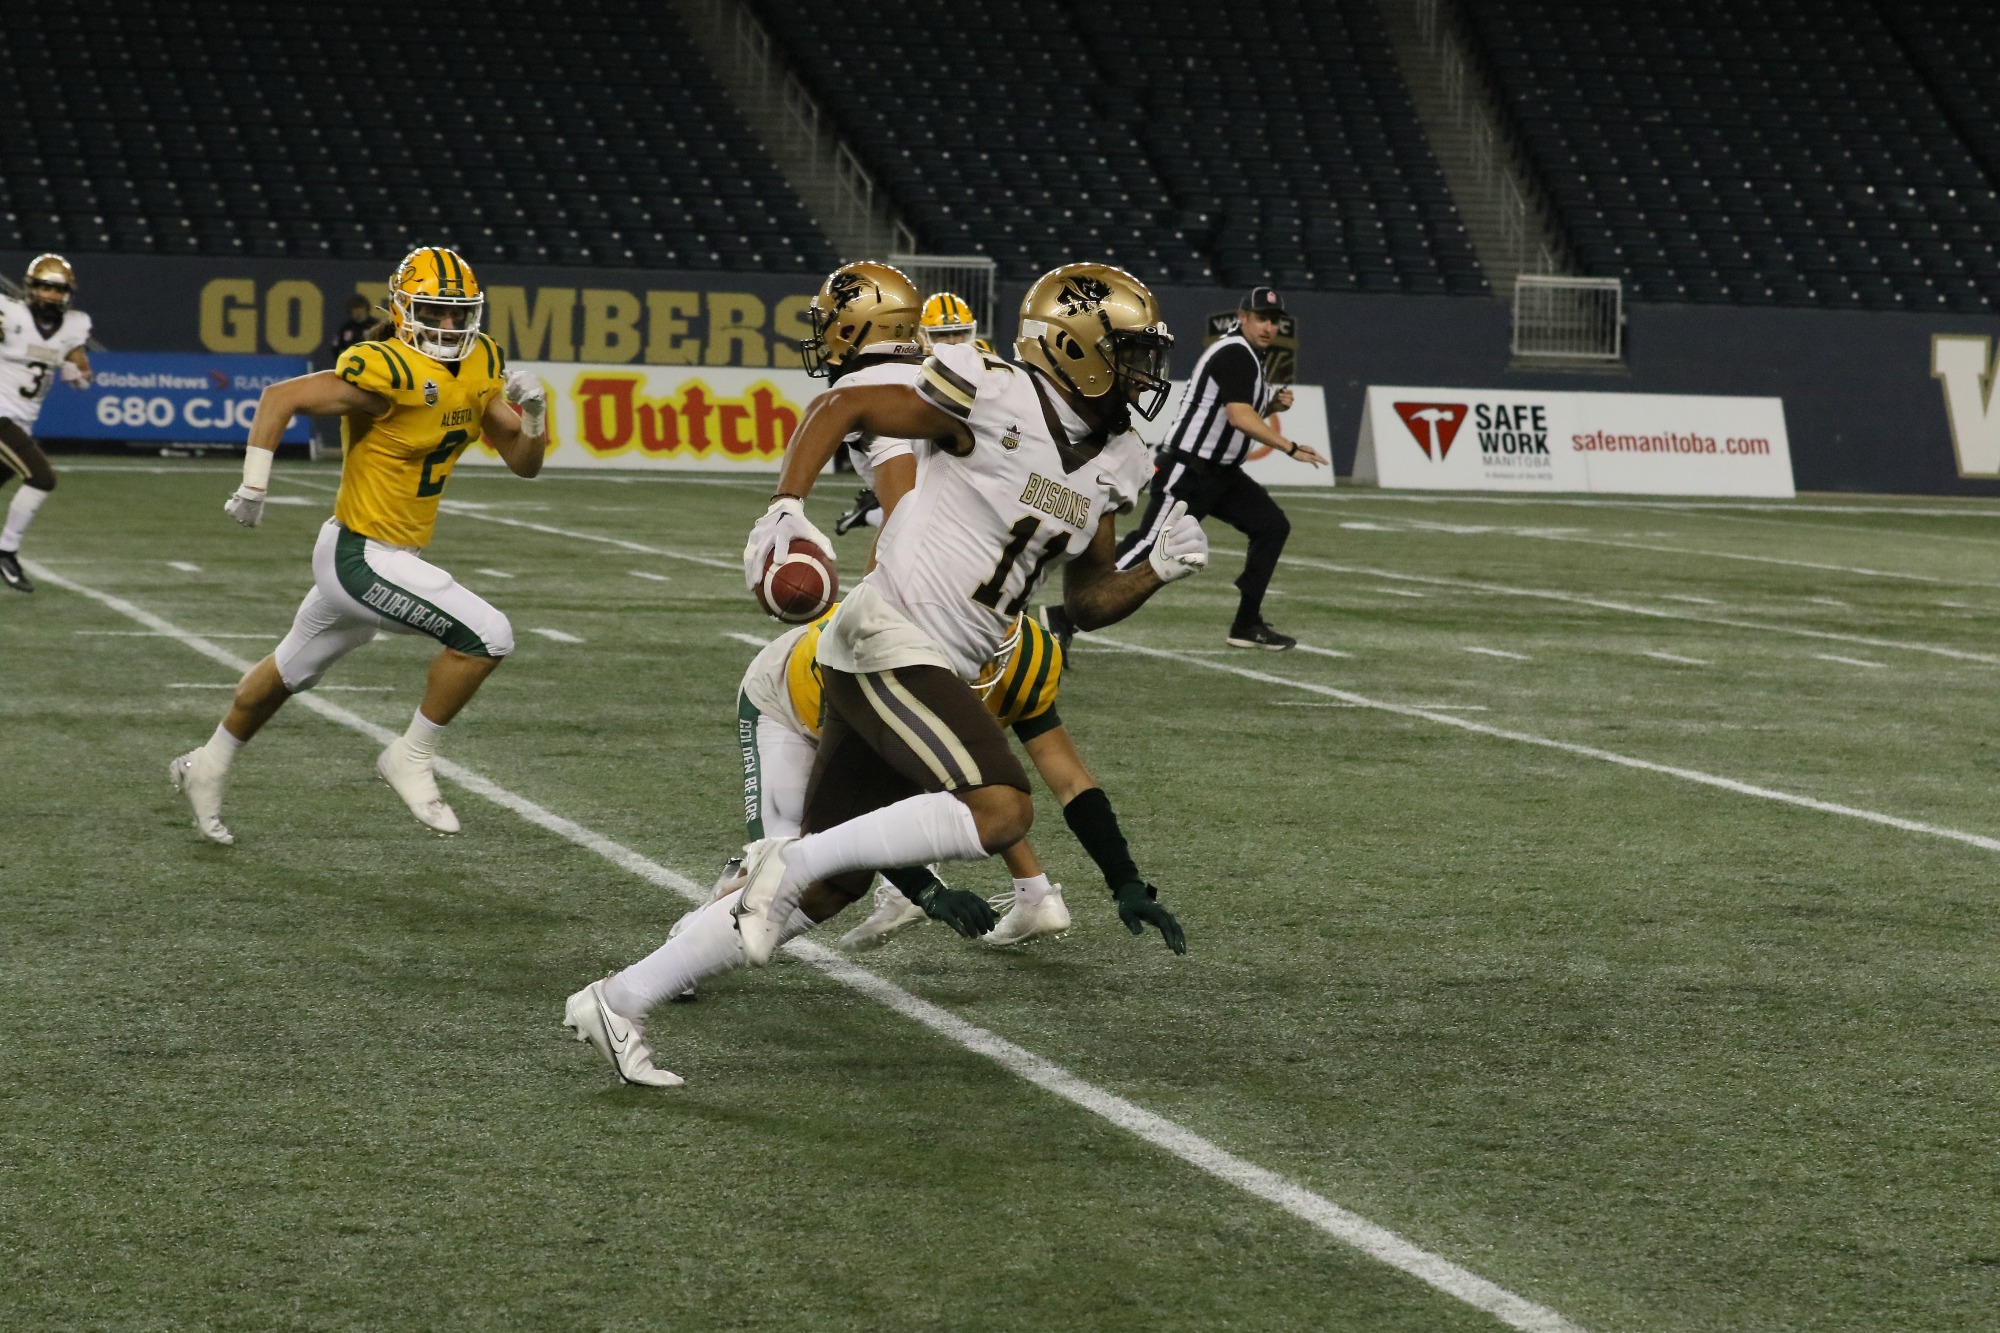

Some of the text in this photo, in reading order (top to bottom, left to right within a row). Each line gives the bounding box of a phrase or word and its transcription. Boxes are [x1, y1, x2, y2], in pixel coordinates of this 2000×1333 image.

[200, 278, 324, 355] GO
[18, 361, 48, 399] 3
[96, 371, 156, 388] Global
[159, 373, 208, 390] News
[342, 355, 366, 386] 2
[96, 395, 175, 428] 680
[440, 407, 473, 428] ALBERTA
[577, 377, 799, 456] Dutch
[1475, 403, 1548, 432] SAFE
[1478, 430, 1550, 456] WORK
[1571, 428, 1770, 457] safemanitoba.com
[416, 428, 469, 498] 2
[1482, 455, 1551, 468] MANITOBA
[1019, 472, 1091, 529] BISONS
[969, 513, 1073, 616] 11
[361, 582, 453, 637] GOLDEN BEARS
